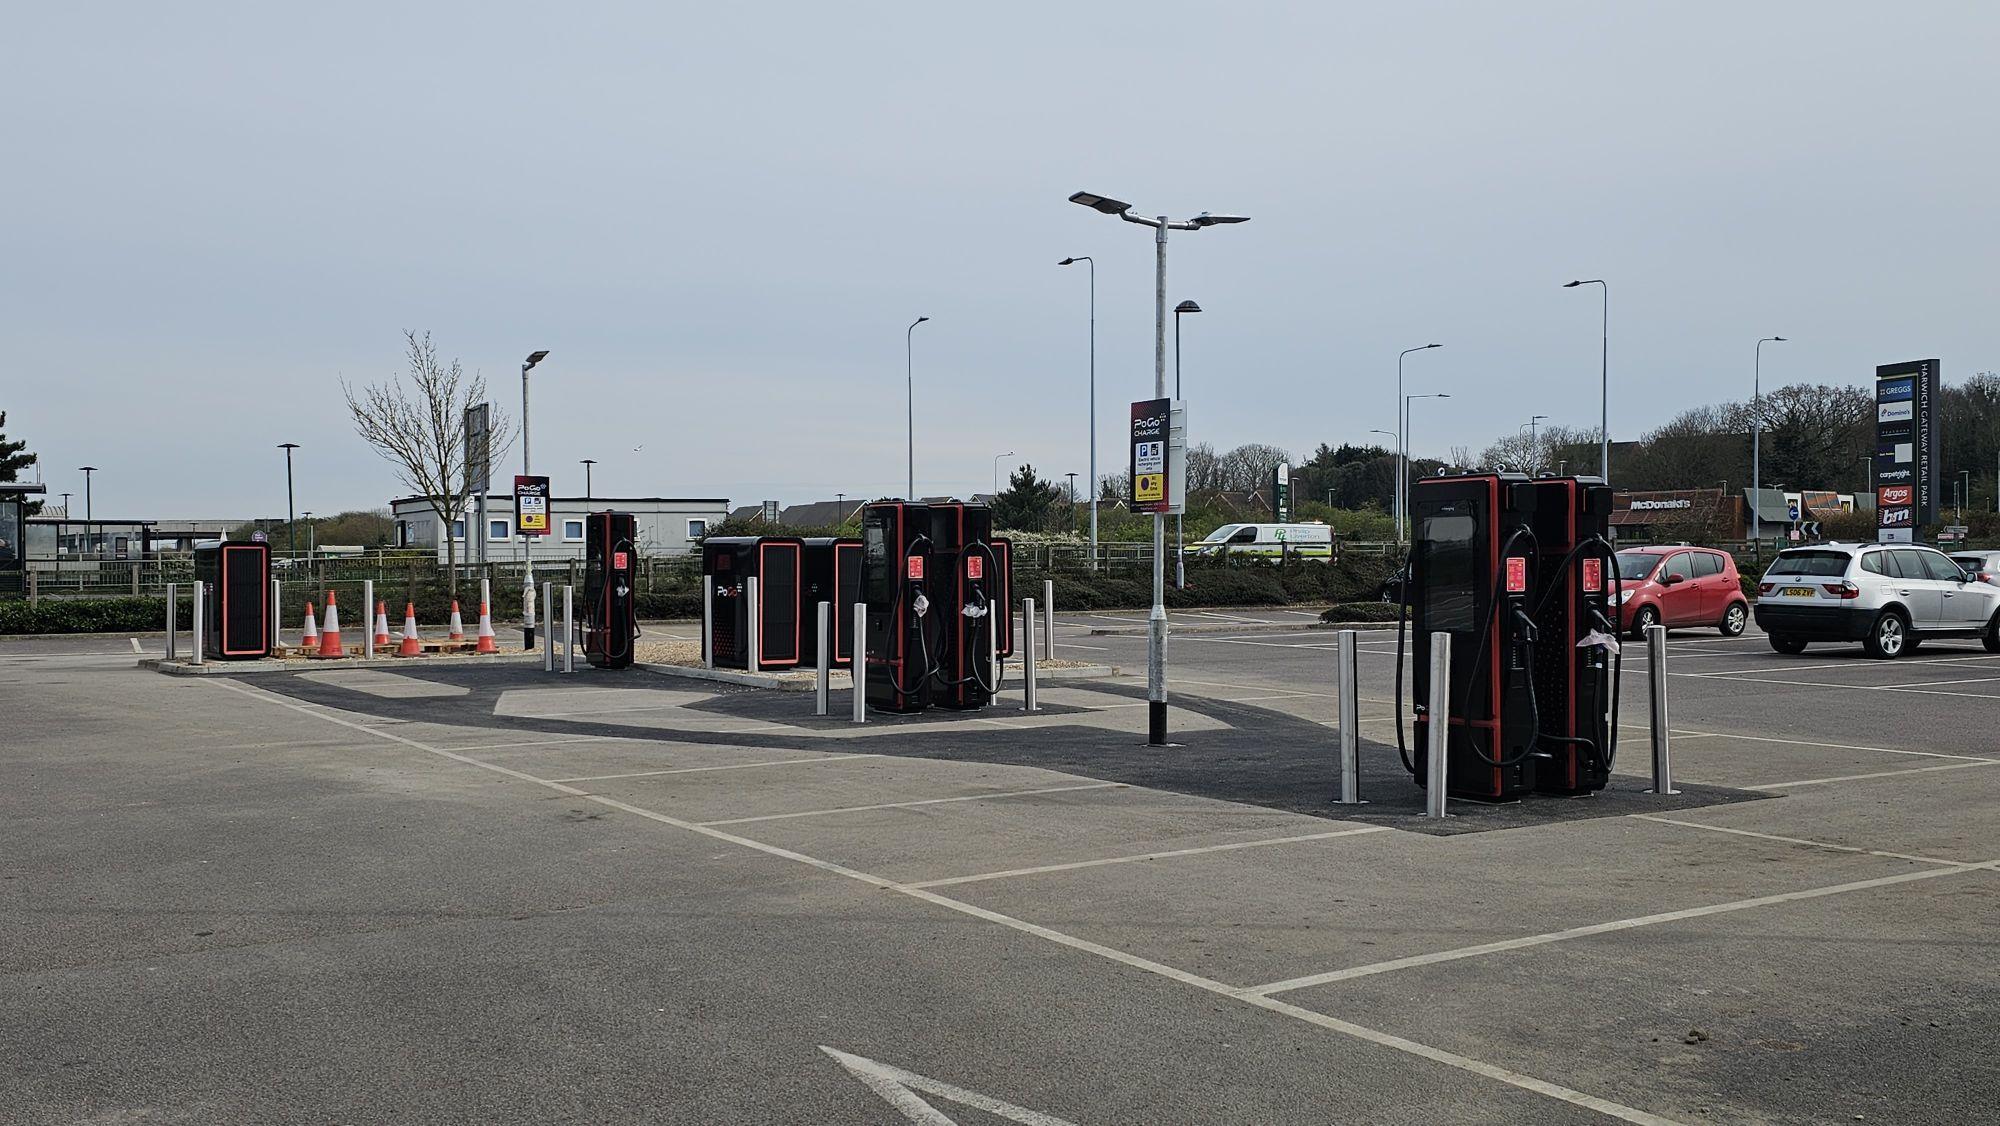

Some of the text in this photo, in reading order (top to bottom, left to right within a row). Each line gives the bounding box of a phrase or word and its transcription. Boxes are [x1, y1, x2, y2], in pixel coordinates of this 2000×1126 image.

[1886, 385, 1911, 395] GREGGS
[1887, 408, 1910, 417] Domino's
[1134, 417, 1160, 429] PoGo
[1134, 428, 1160, 437] CHARGE
[1920, 410, 1928, 453] GATEWAY
[1920, 455, 1928, 484] RETAIL
[1883, 488, 1908, 500] Argos
[1920, 485, 1928, 507] PARK
[1631, 500, 1690, 510] McDonald's
